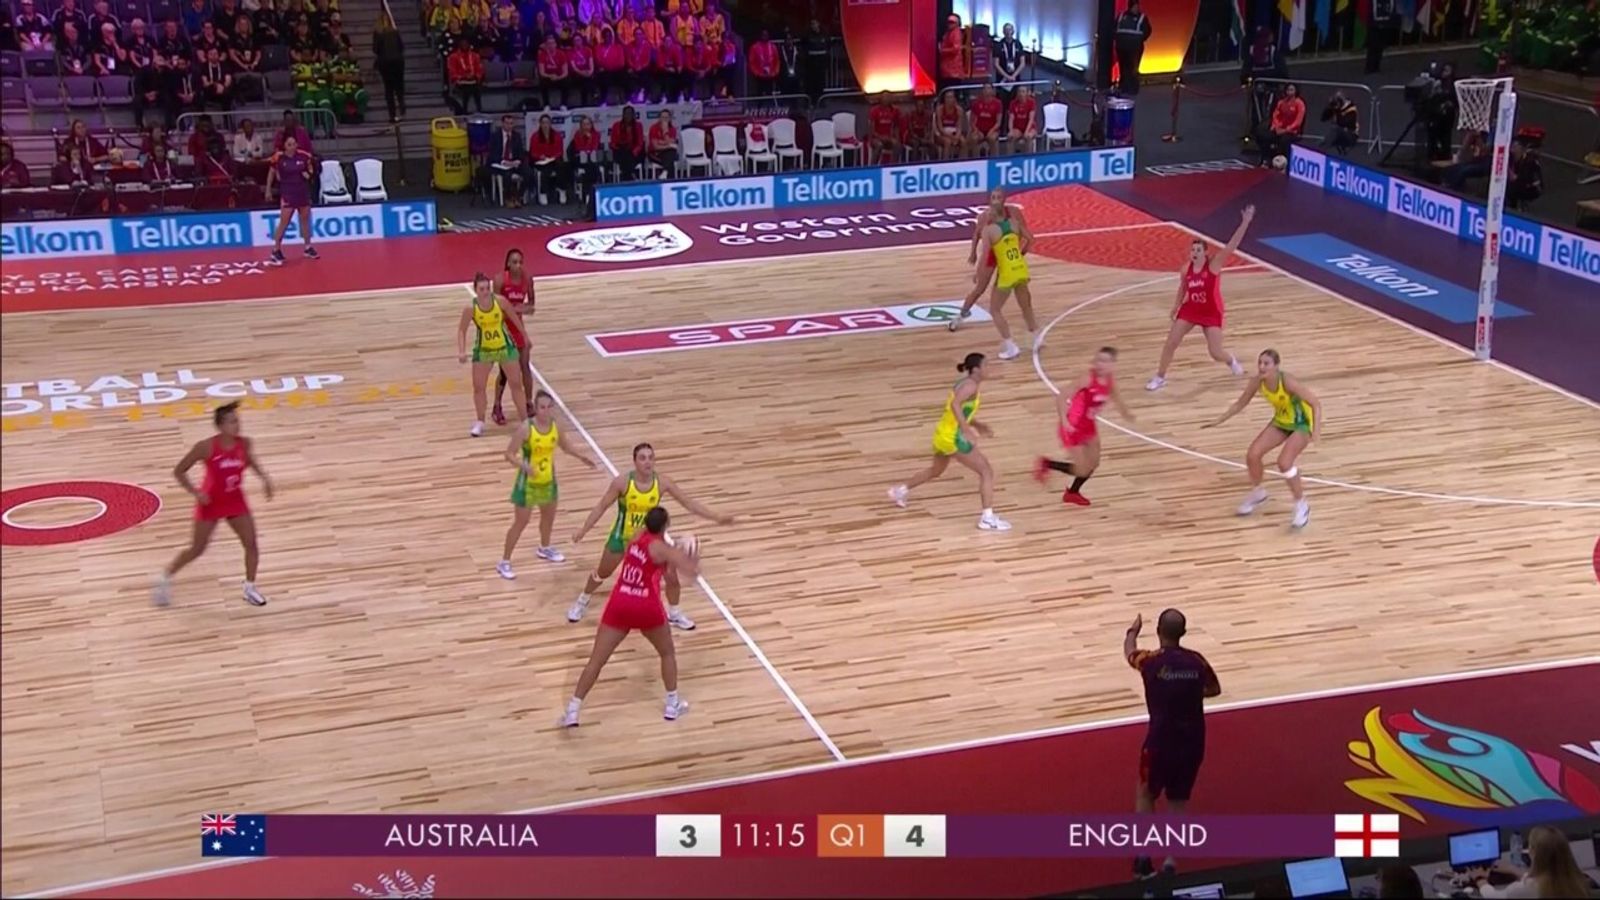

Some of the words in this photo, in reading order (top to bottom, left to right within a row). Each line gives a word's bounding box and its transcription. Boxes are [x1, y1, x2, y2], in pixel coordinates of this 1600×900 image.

[671, 184, 766, 211] Telkom
[782, 175, 874, 203] Telkom
[891, 167, 980, 193] Telkom
[996, 158, 1083, 186] Telkom
[1099, 151, 1132, 176] Tel
[700, 211, 897, 235] Western
[909, 202, 1024, 218] Cap
[1329, 160, 1384, 205] Telkom
[1394, 183, 1455, 228] Telkom
[1466, 206, 1535, 256] Teom
[122, 218, 242, 249] Telkom
[261, 213, 374, 241] Tekom
[391, 203, 434, 233] Tel
[718, 216, 979, 245] Governmen
[96, 266, 178, 276] CAPE
[1325, 253, 1440, 298] Telkom
[668, 312, 897, 345] SPAR
[2, 369, 211, 398] TBALL
[205, 374, 345, 397] CUP
